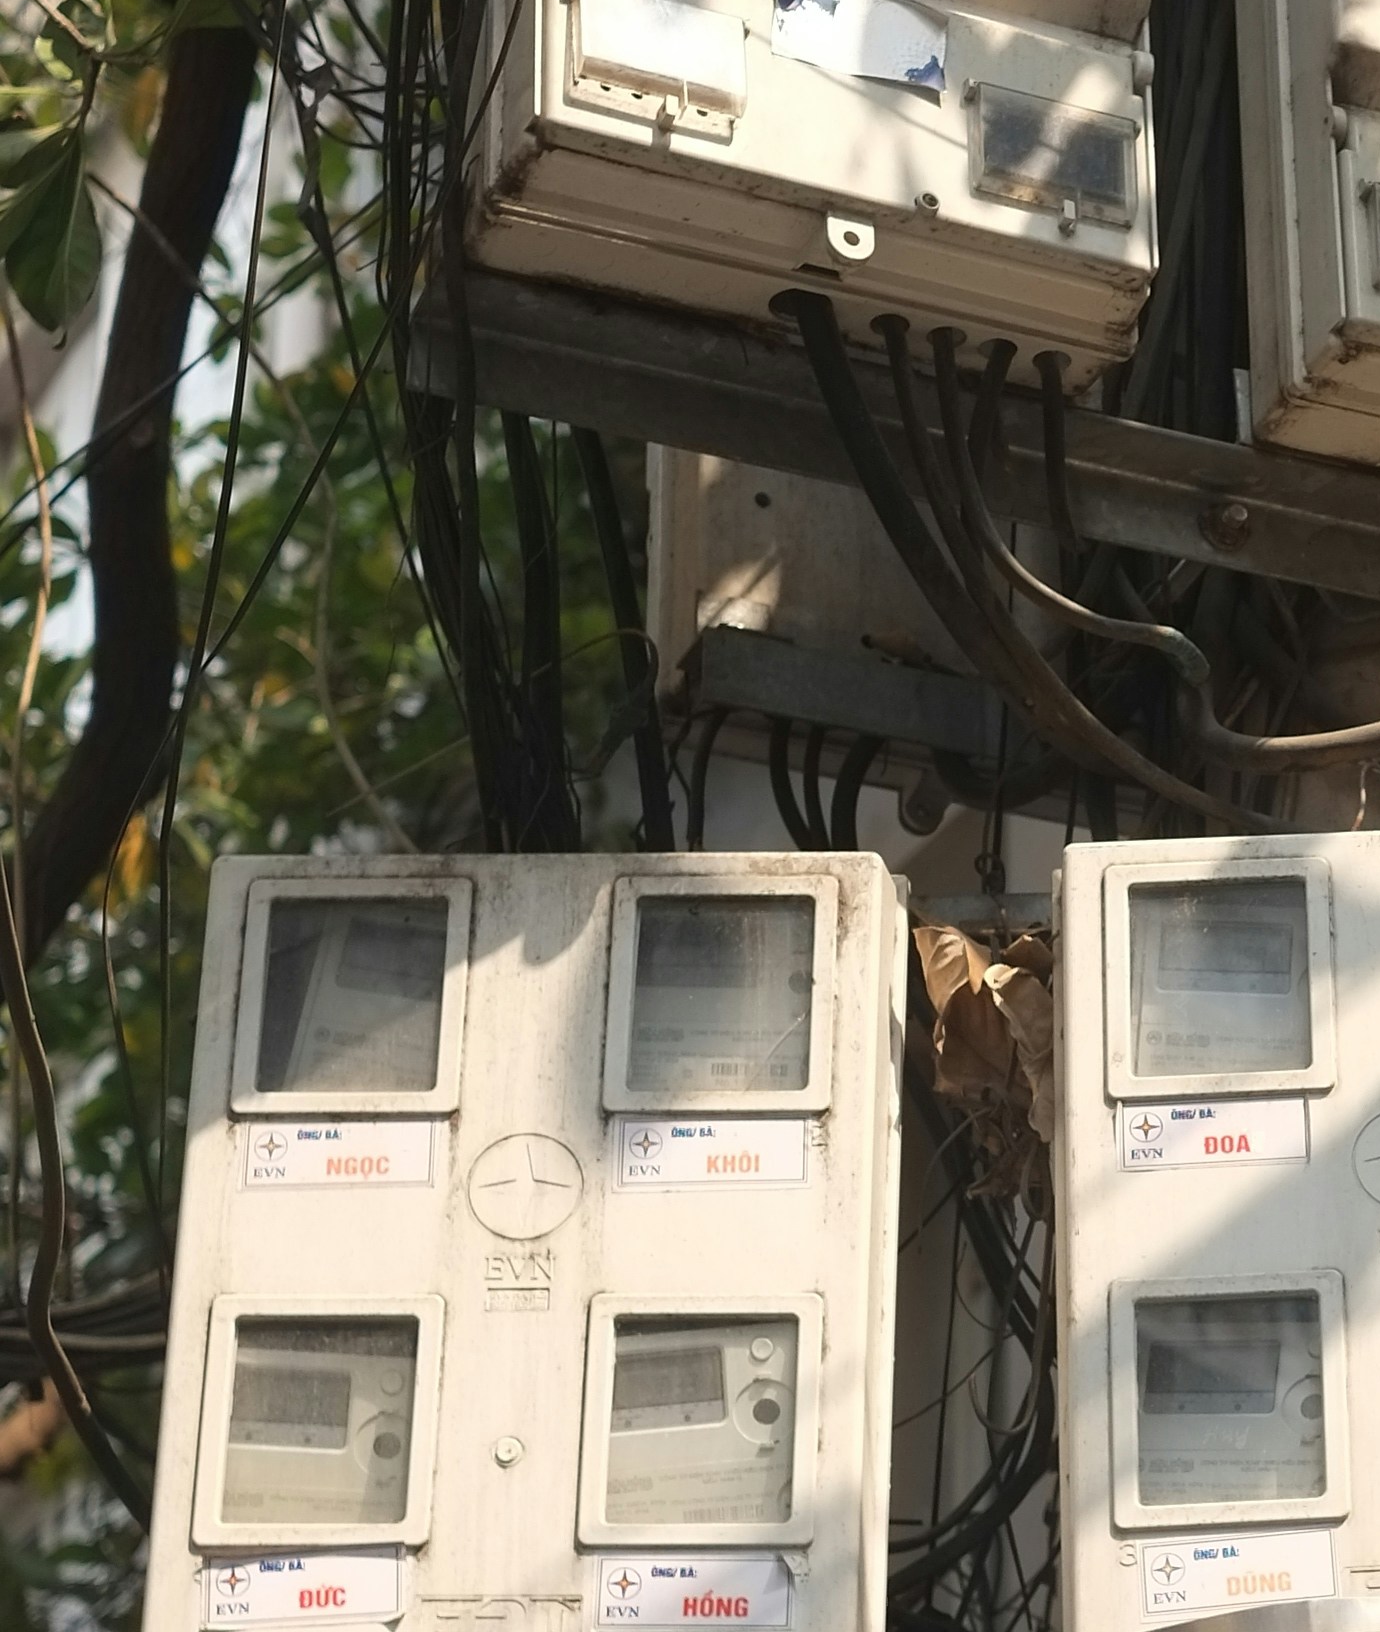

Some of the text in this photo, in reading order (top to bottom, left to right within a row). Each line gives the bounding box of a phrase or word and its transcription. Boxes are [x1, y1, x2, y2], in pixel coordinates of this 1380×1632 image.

[1203, 1135, 1251, 1154] ĐOA
[1131, 1148, 1163, 1160] EVN
[326, 1156, 390, 1179] NGỌC
[706, 1151, 760, 1173] KHÔI
[253, 1167, 286, 1178] EVN
[629, 1165, 661, 1176] EVN
[484, 1254, 556, 1280] EVN
[298, 1584, 346, 1609] ĐỨC
[1153, 1590, 1187, 1605] EVN
[216, 1602, 250, 1616] EVN
[605, 1605, 640, 1618] EVN
